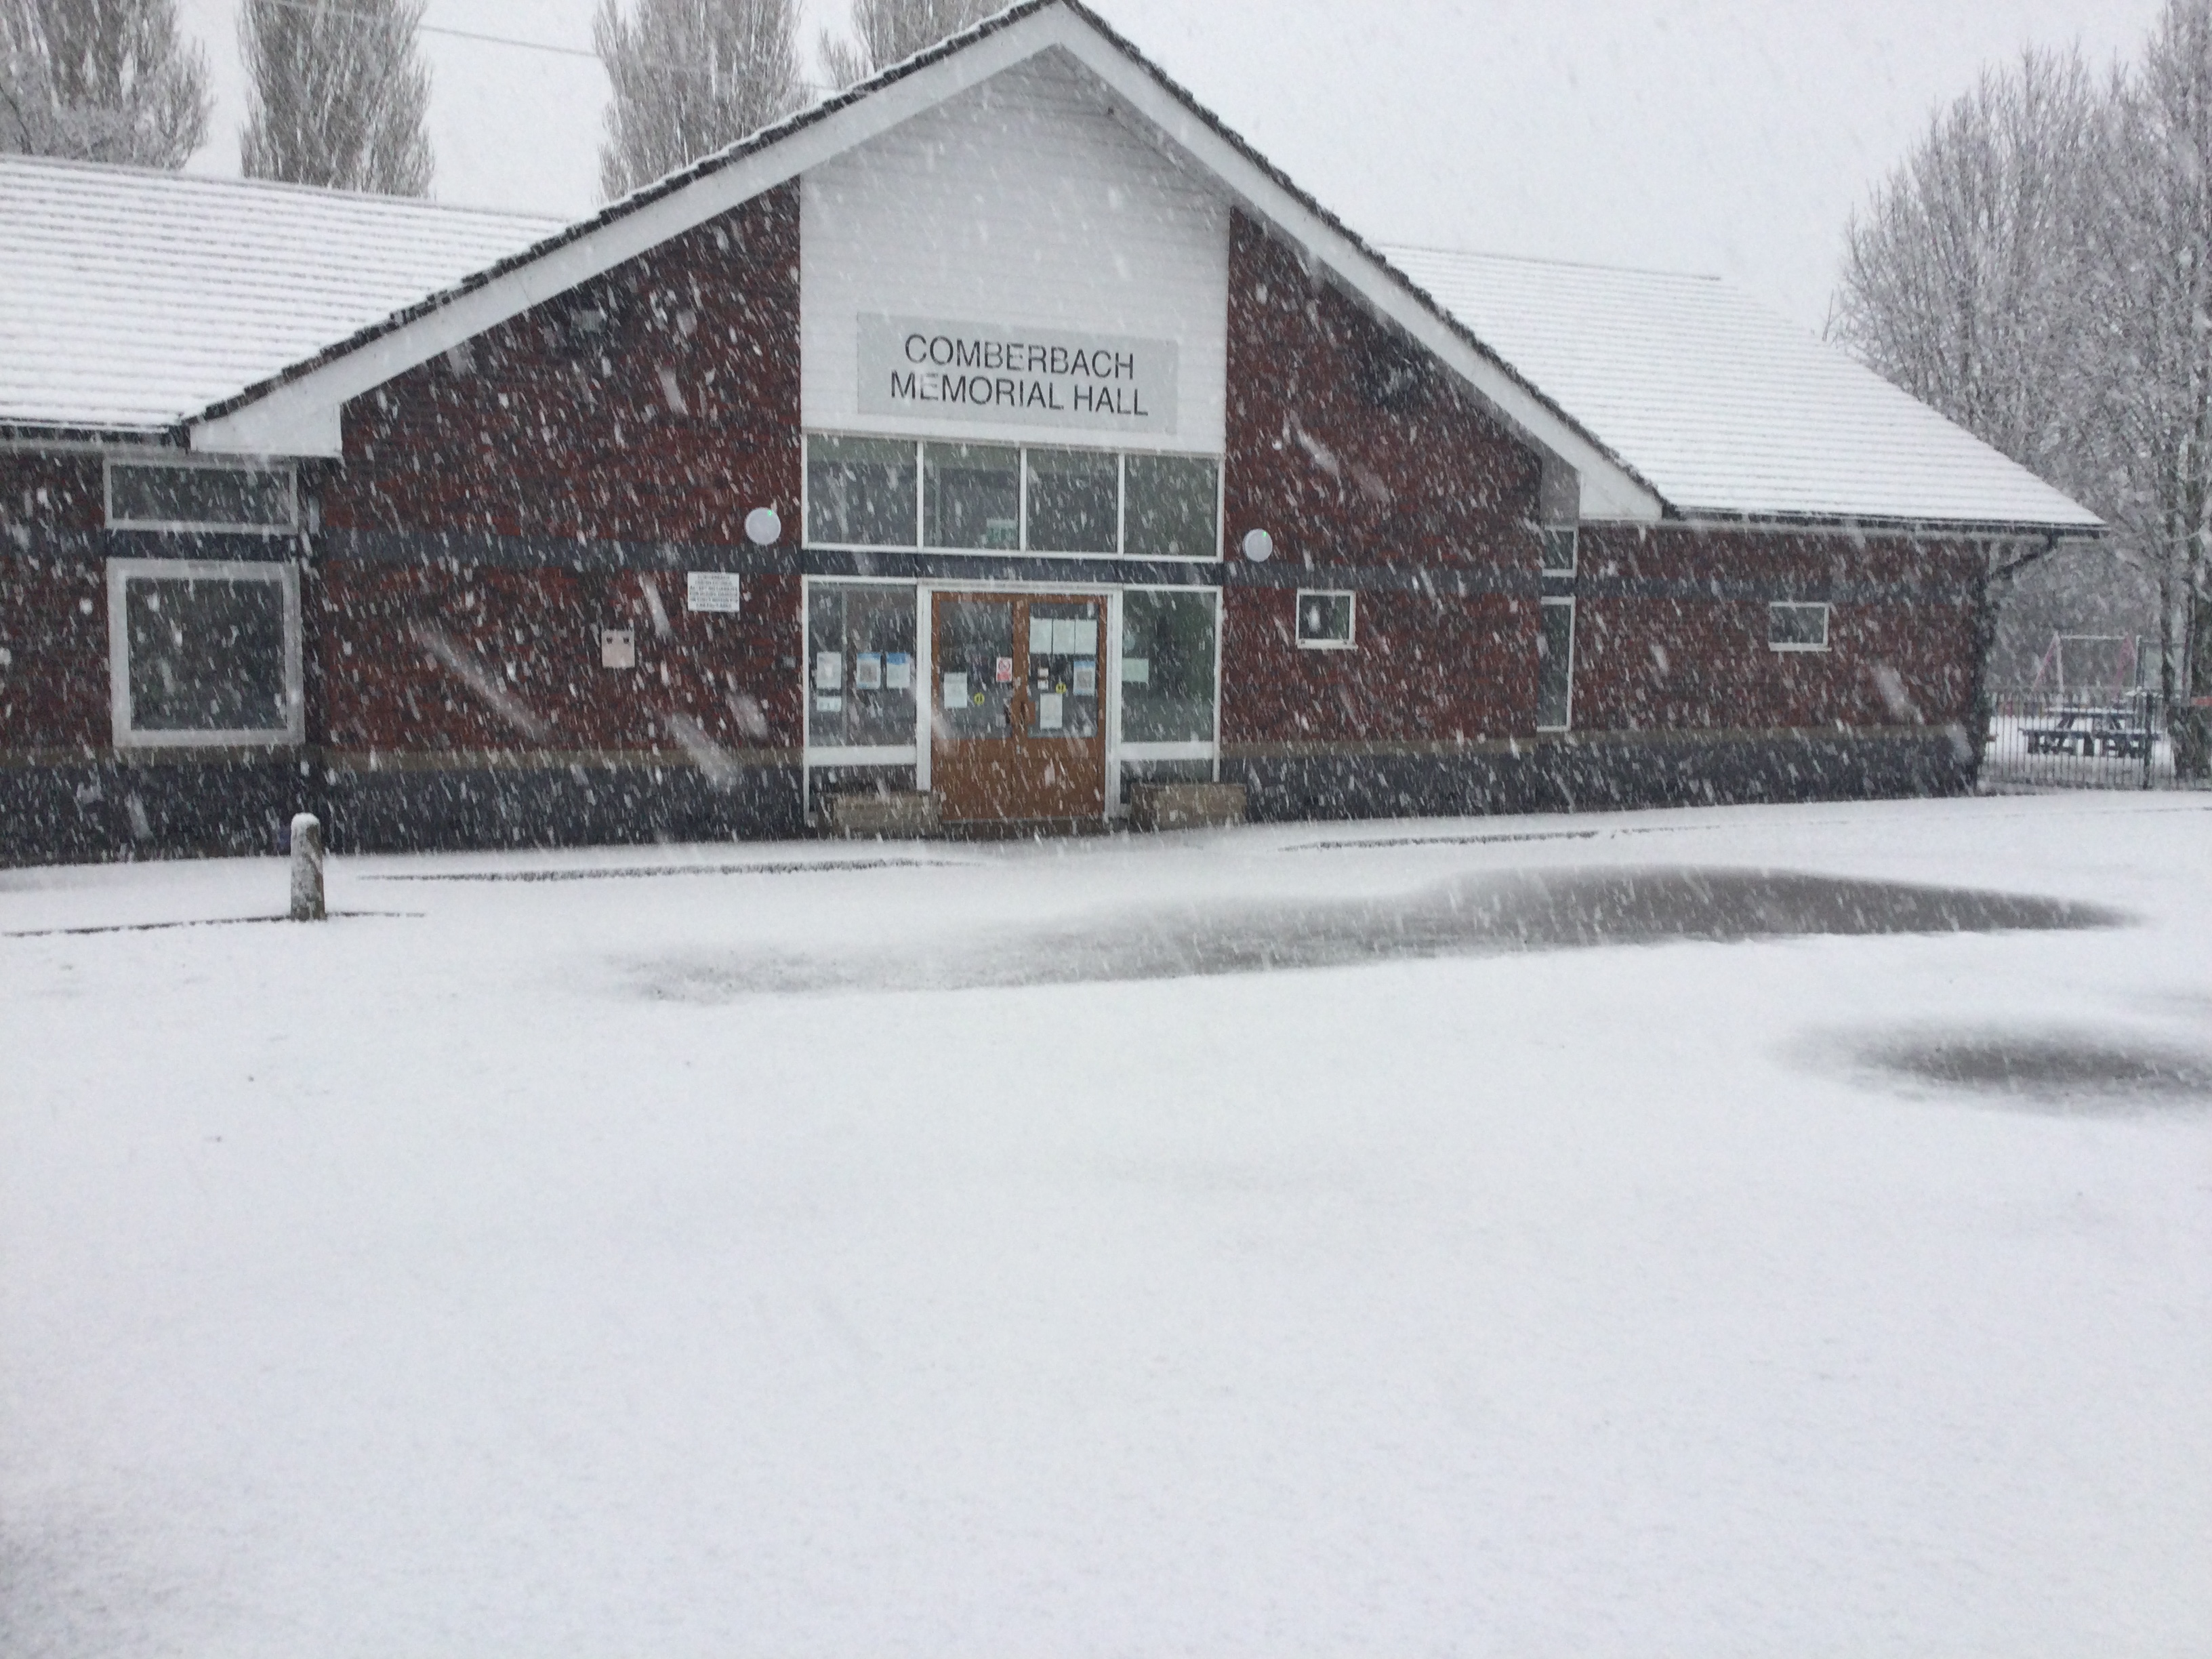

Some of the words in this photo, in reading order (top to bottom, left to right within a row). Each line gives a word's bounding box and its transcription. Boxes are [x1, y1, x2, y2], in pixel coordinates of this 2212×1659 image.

[905, 333, 1134, 380] COMBERBACH
[890, 369, 1064, 410] MEMORIAL
[1073, 384, 1149, 415] HALL
